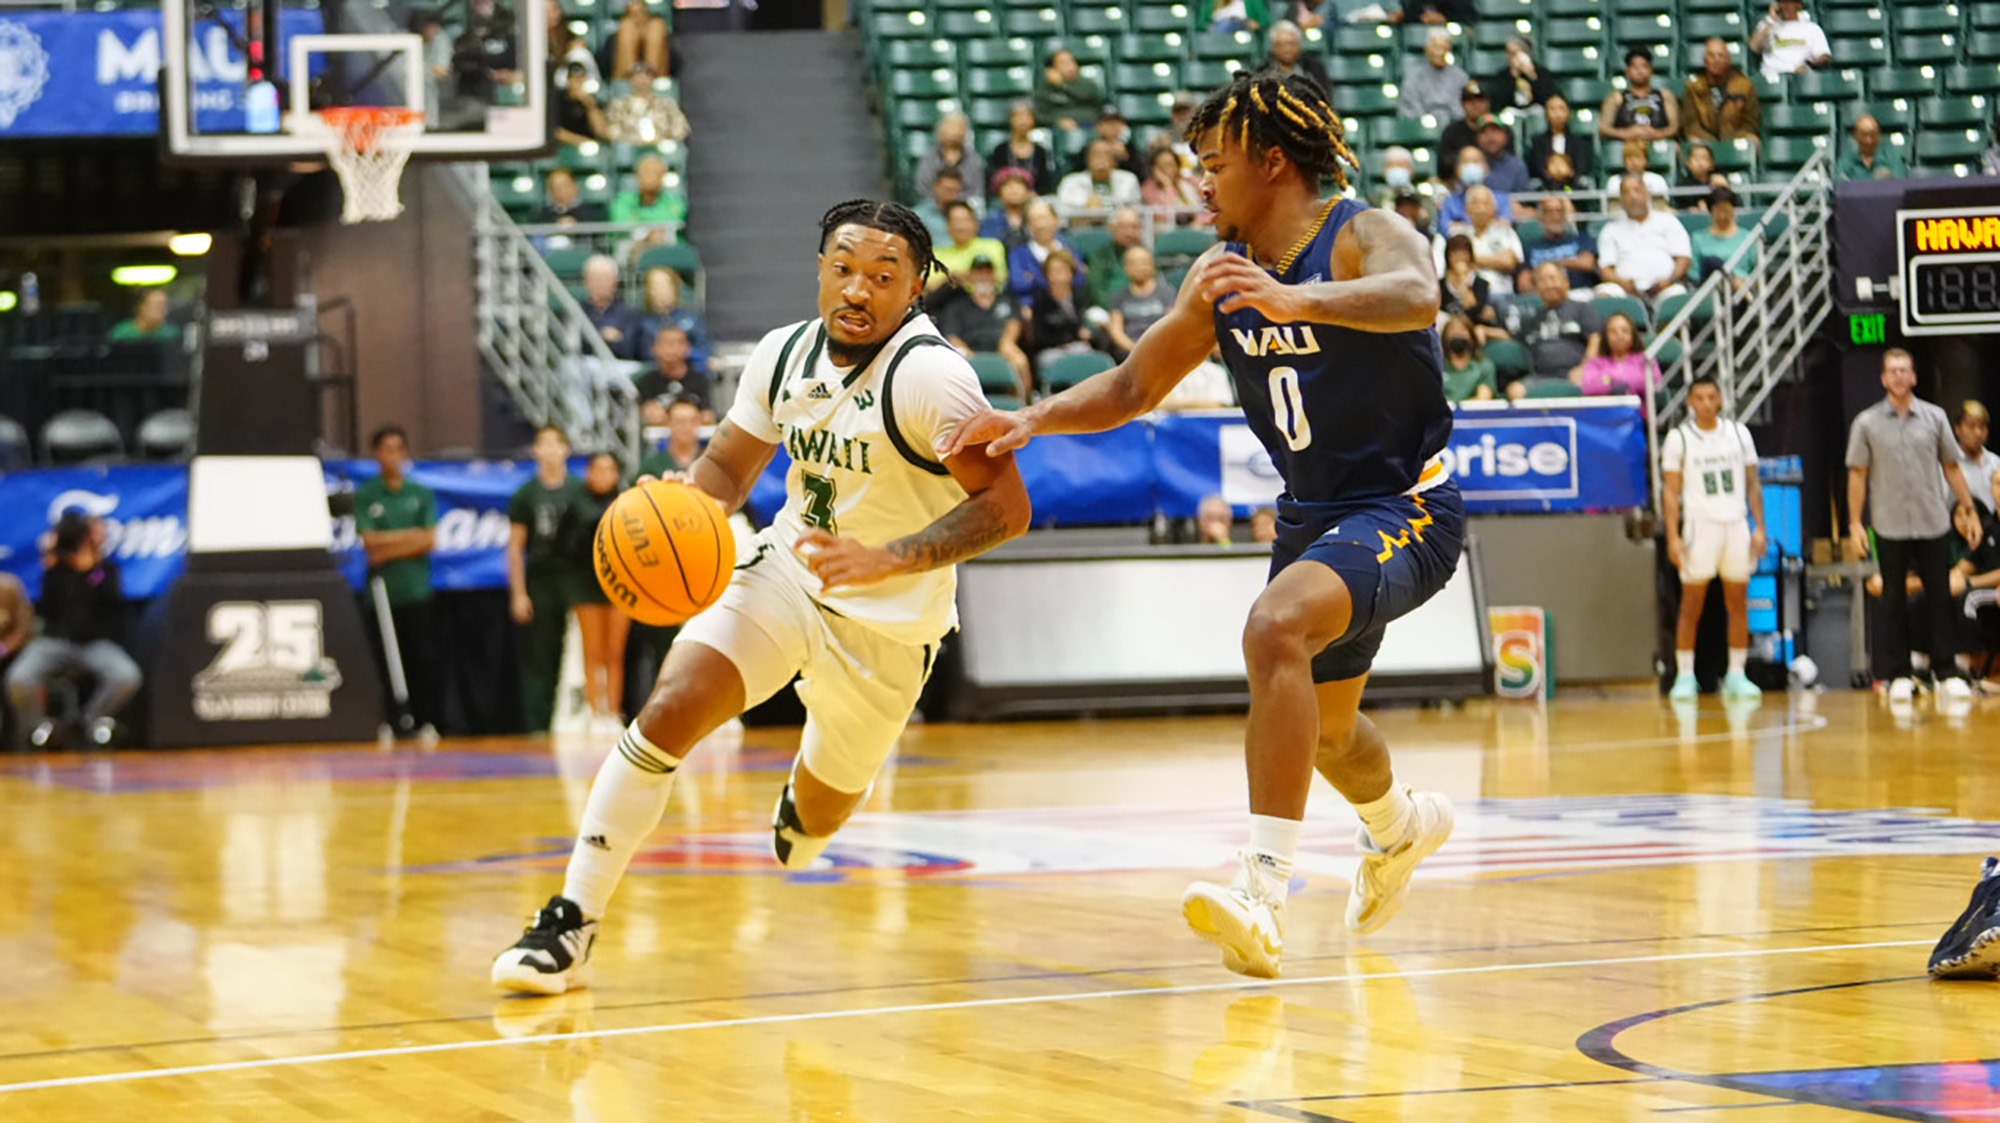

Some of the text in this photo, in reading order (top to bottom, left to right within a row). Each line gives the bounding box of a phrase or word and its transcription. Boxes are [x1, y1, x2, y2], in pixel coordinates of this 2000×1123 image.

[1850, 313, 1886, 344] EXIT
[1268, 366, 1312, 452] 0
[777, 423, 873, 475] AWAI'I
[206, 600, 322, 672] 25
